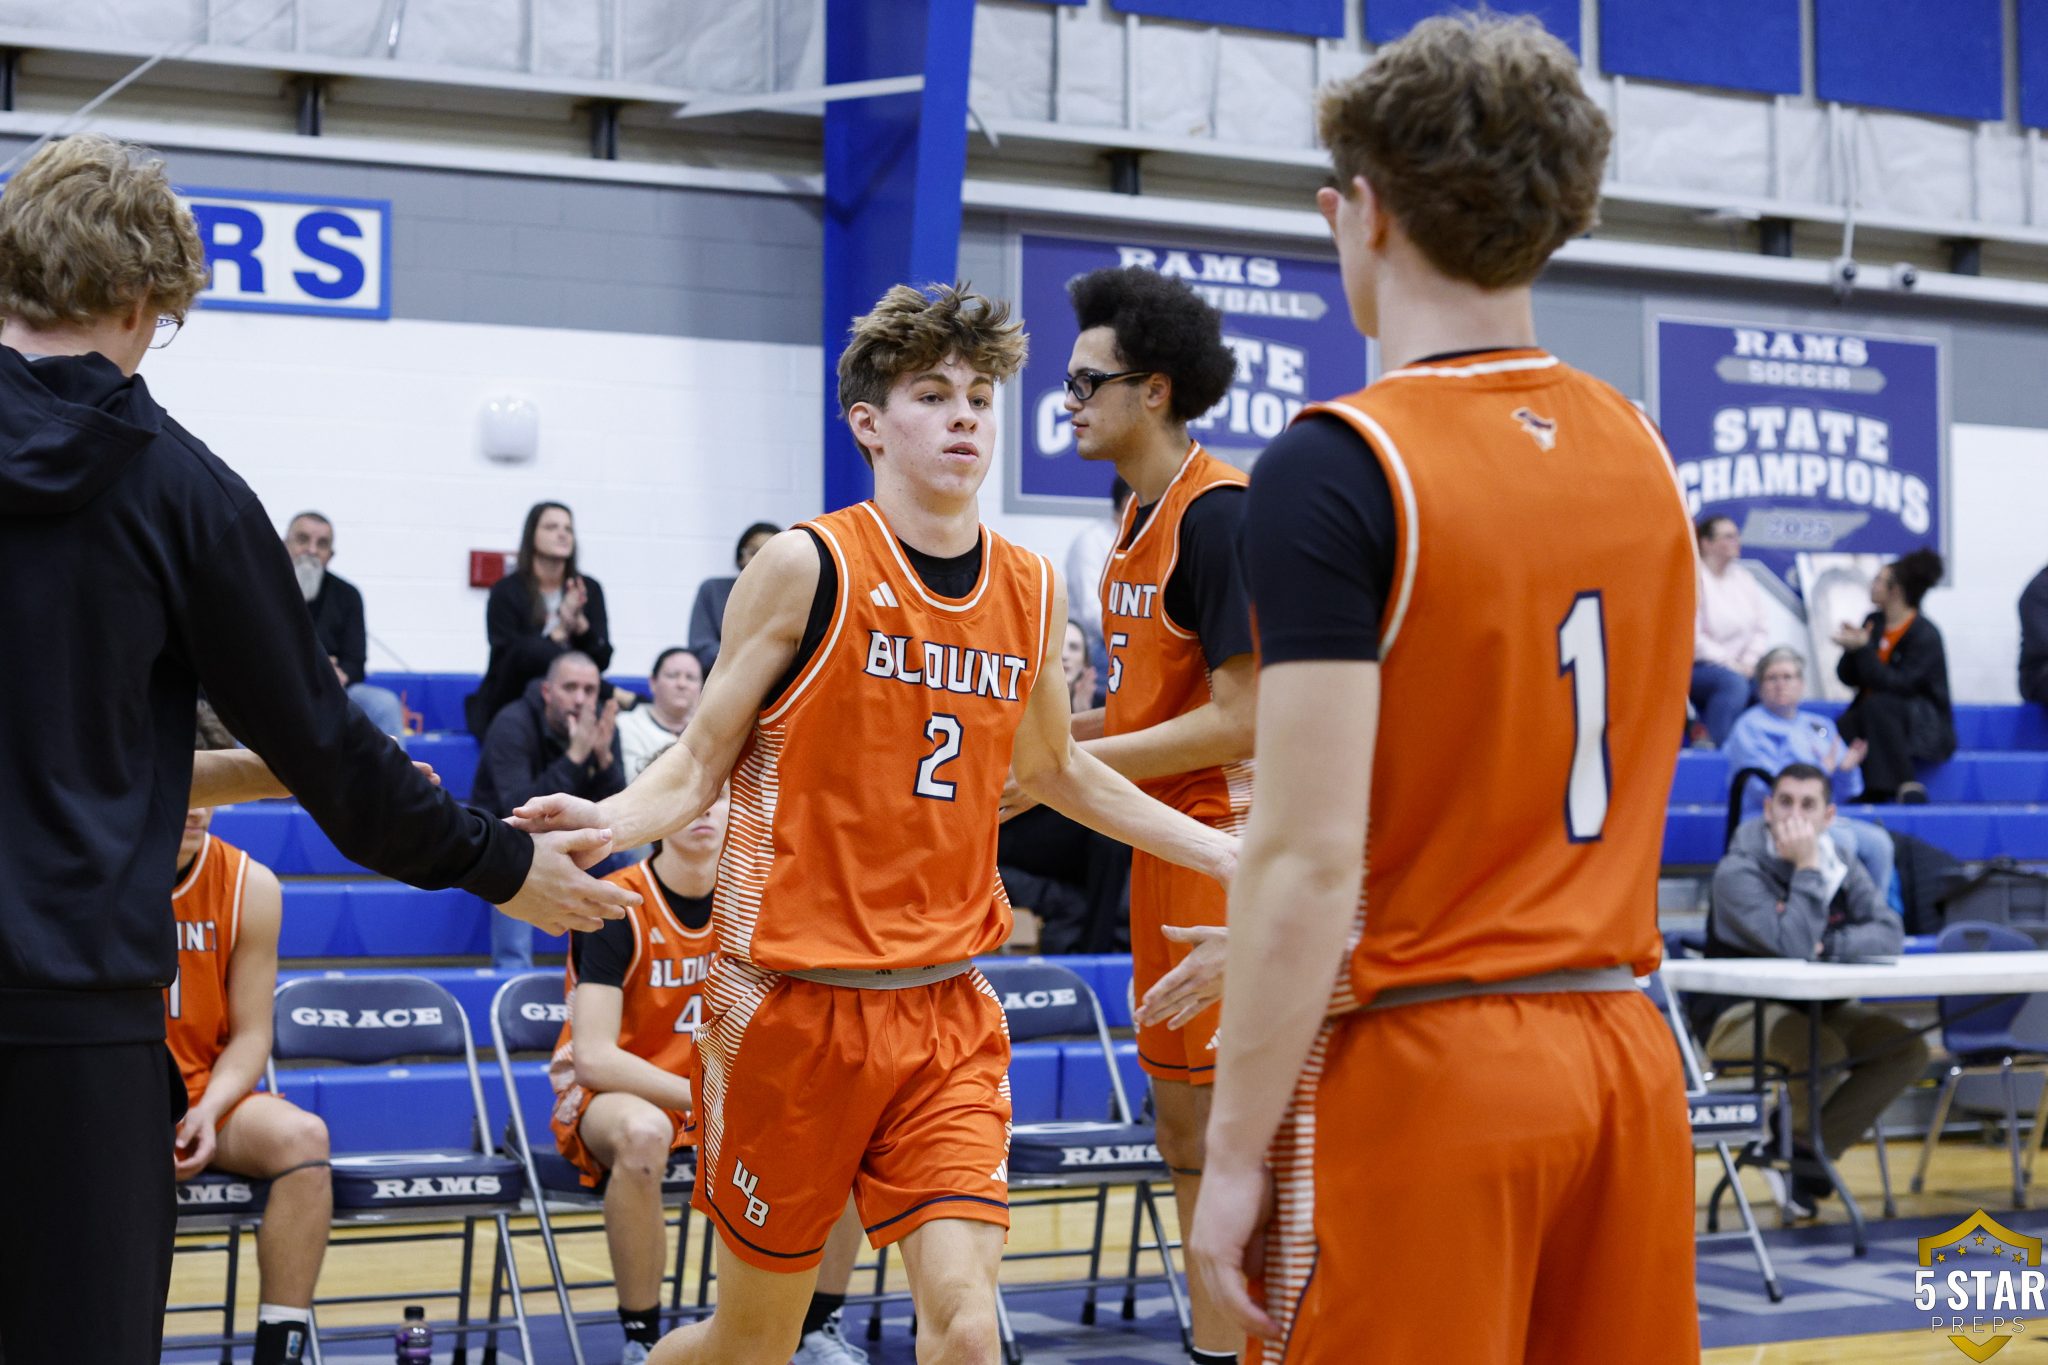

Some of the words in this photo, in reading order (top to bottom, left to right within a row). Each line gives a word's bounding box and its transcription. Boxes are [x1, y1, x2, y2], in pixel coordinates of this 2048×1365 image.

[190, 204, 365, 300] RS
[1196, 285, 1310, 320] TBALL
[1734, 328, 1869, 366] RAMS
[1748, 359, 1851, 390] SOCCER
[1713, 406, 1889, 464] STATE
[1677, 452, 1930, 535] CHAMPIONS
[863, 630, 1028, 702] BLOUNT
[1556, 590, 1612, 844] 1
[912, 711, 964, 802] 2
[290, 1006, 444, 1029] GRACE
[673, 993, 703, 1044] 4
[1003, 988, 1078, 1011] ACE
[1687, 1104, 1758, 1126] AMS
[371, 1176, 502, 1199] RAMS
